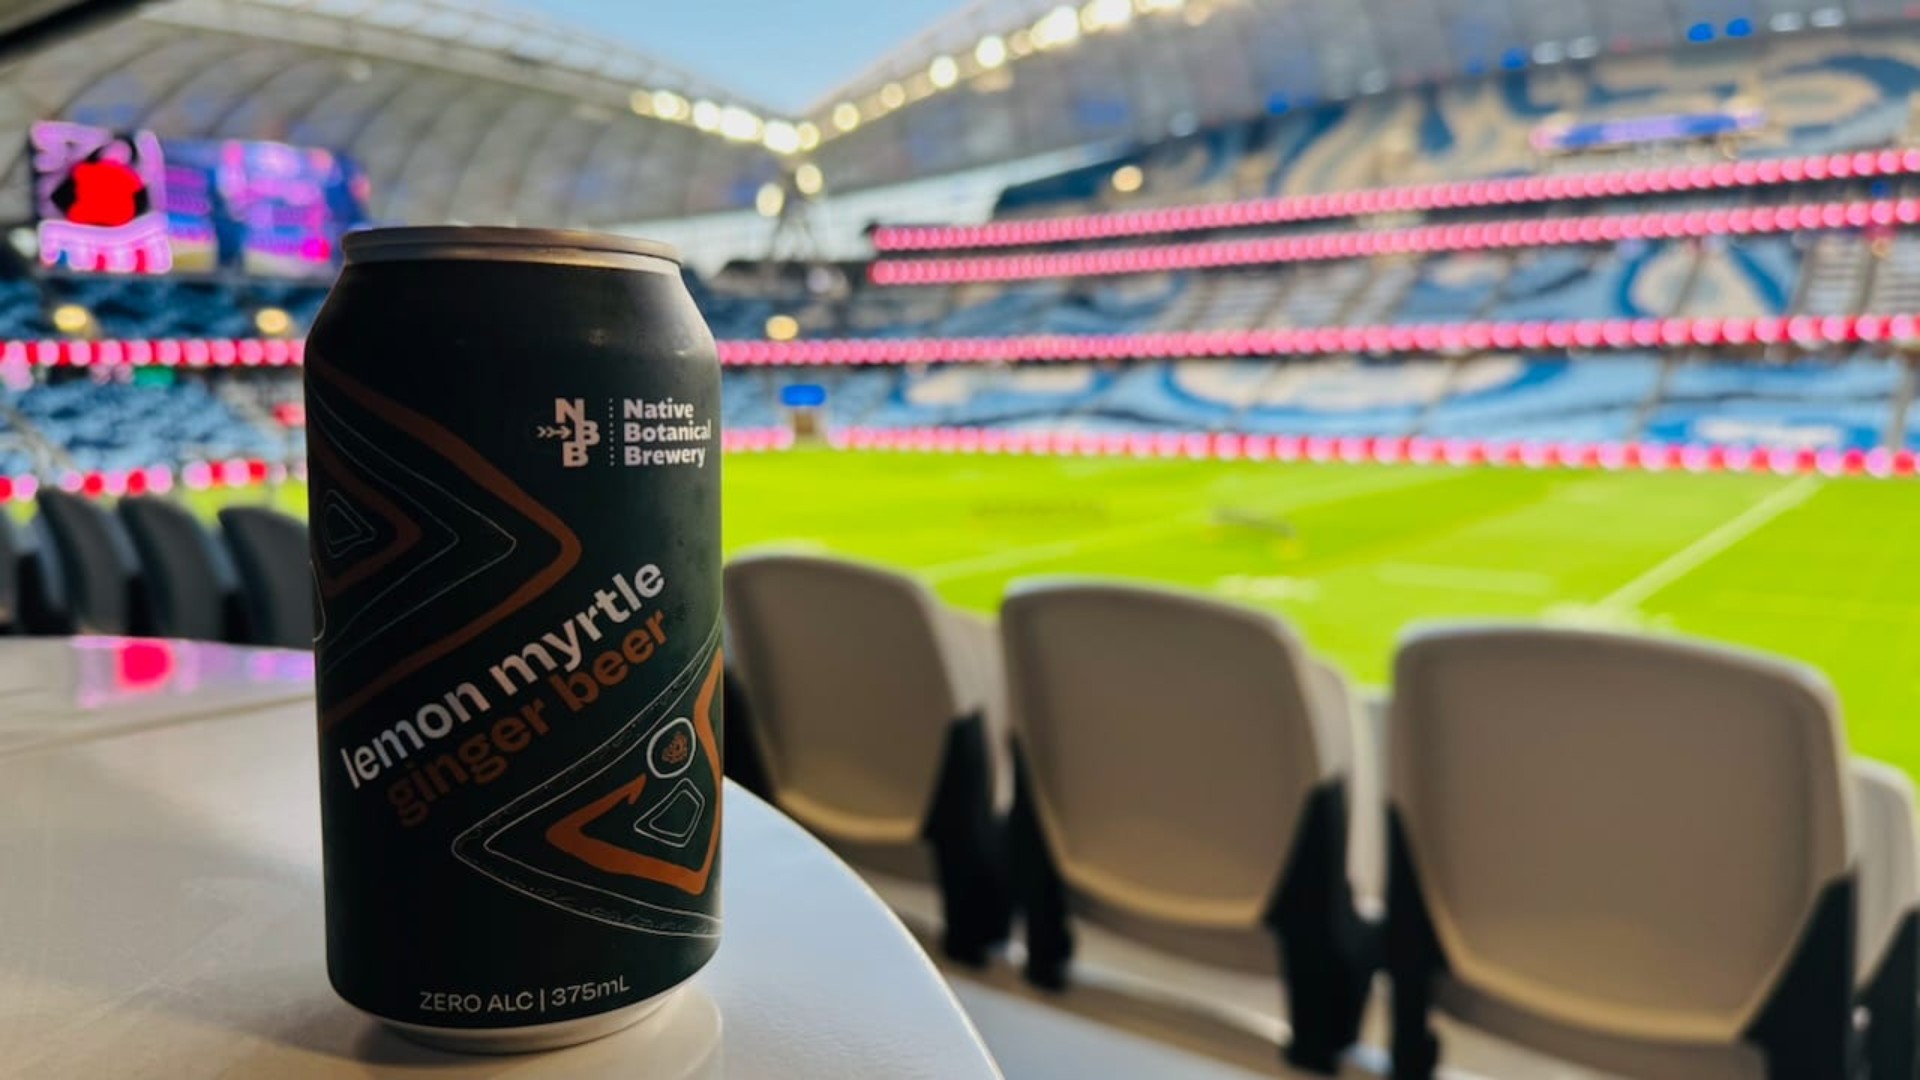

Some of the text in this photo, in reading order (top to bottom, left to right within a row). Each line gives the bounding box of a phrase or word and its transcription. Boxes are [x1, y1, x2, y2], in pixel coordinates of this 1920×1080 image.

[623, 397, 694, 418] Native
[623, 419, 712, 442] Botanical
[623, 445, 706, 468] Brewery
[340, 563, 666, 790] lemon myrtle
[386, 609, 667, 827] ginger beer
[419, 991, 482, 1013] ZERO
[487, 991, 533, 1012] ALC
[551, 975, 631, 1007] 375mL
